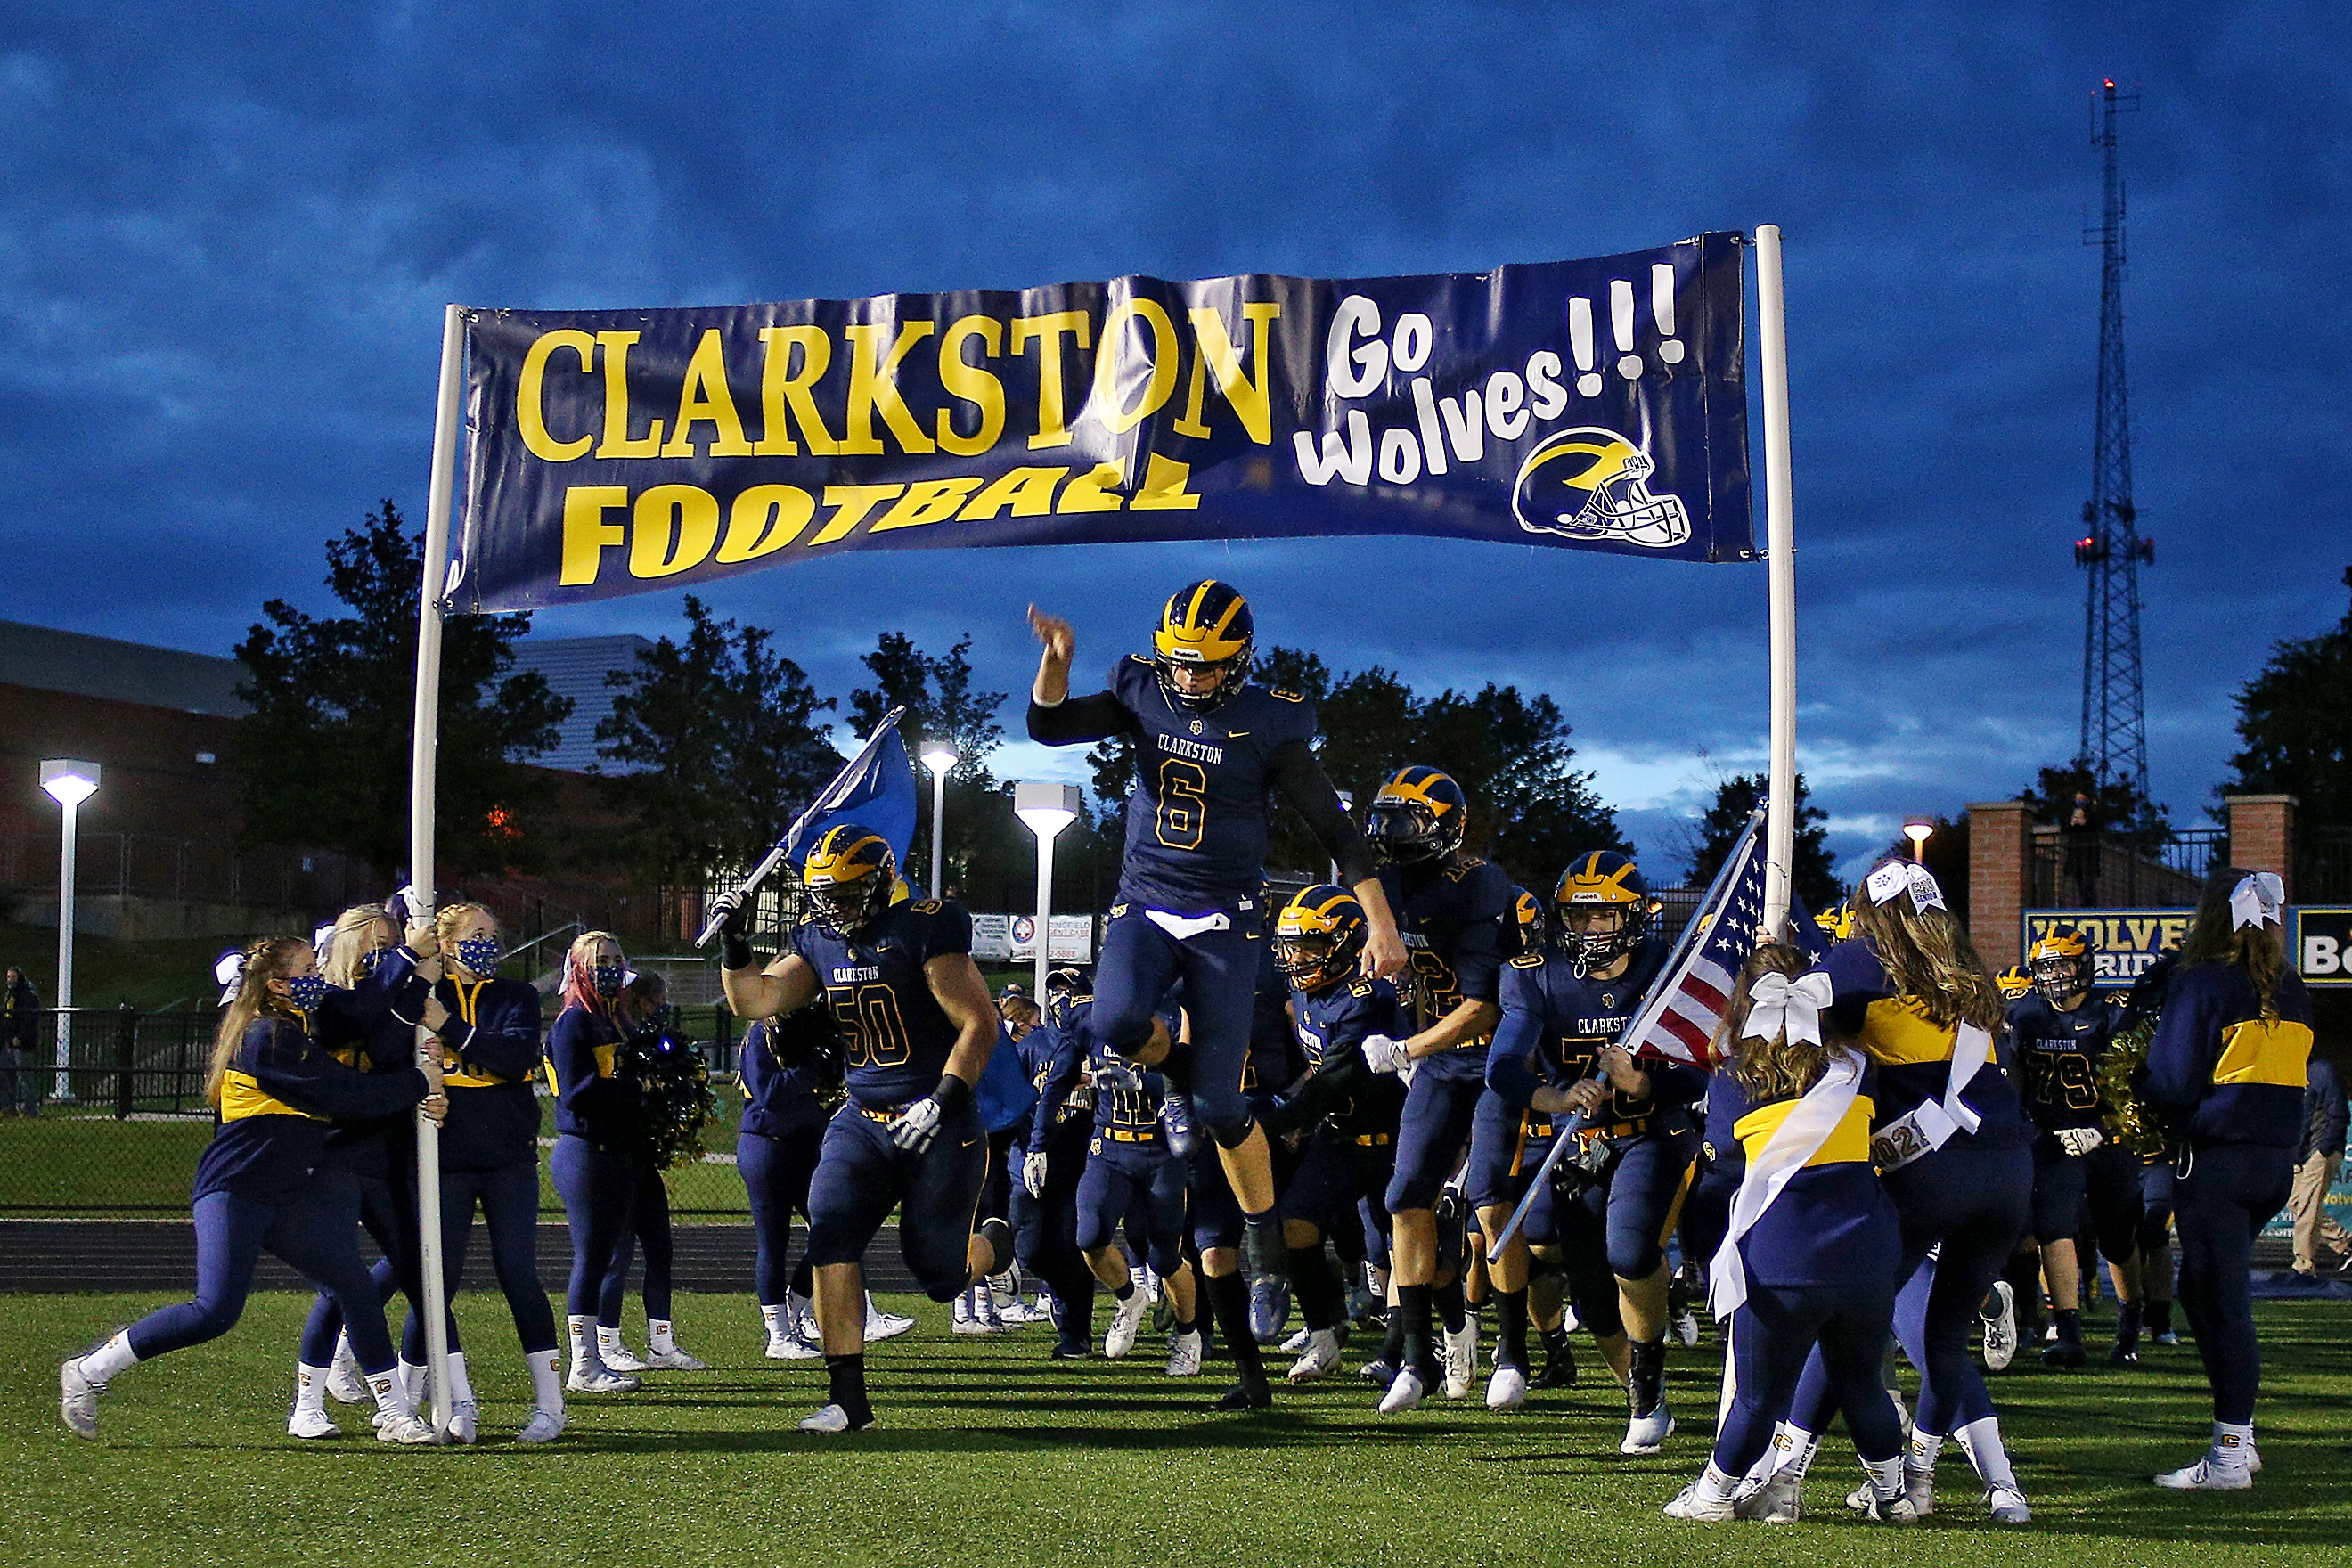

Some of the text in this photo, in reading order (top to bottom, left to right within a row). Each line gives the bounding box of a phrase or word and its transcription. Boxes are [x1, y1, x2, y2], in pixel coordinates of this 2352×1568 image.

[1327, 294, 1433, 399] Go
[515, 297, 1281, 463] CLARKSTON
[559, 451, 1202, 586] FOOTBALL
[1157, 733, 1223, 765] CLARKSTON
[1155, 757, 1206, 850] 6
[2032, 919, 2198, 951] OLVE
[2304, 935, 2352, 974] B
[833, 965, 879, 984] CLARKSTON
[2090, 953, 2167, 977] RID
[826, 983, 911, 1068] 50
[1577, 1016, 1633, 1033] CLARKST
[2036, 1038, 2077, 1051] CLARKSTON
[2030, 1049, 2099, 1109] 79
